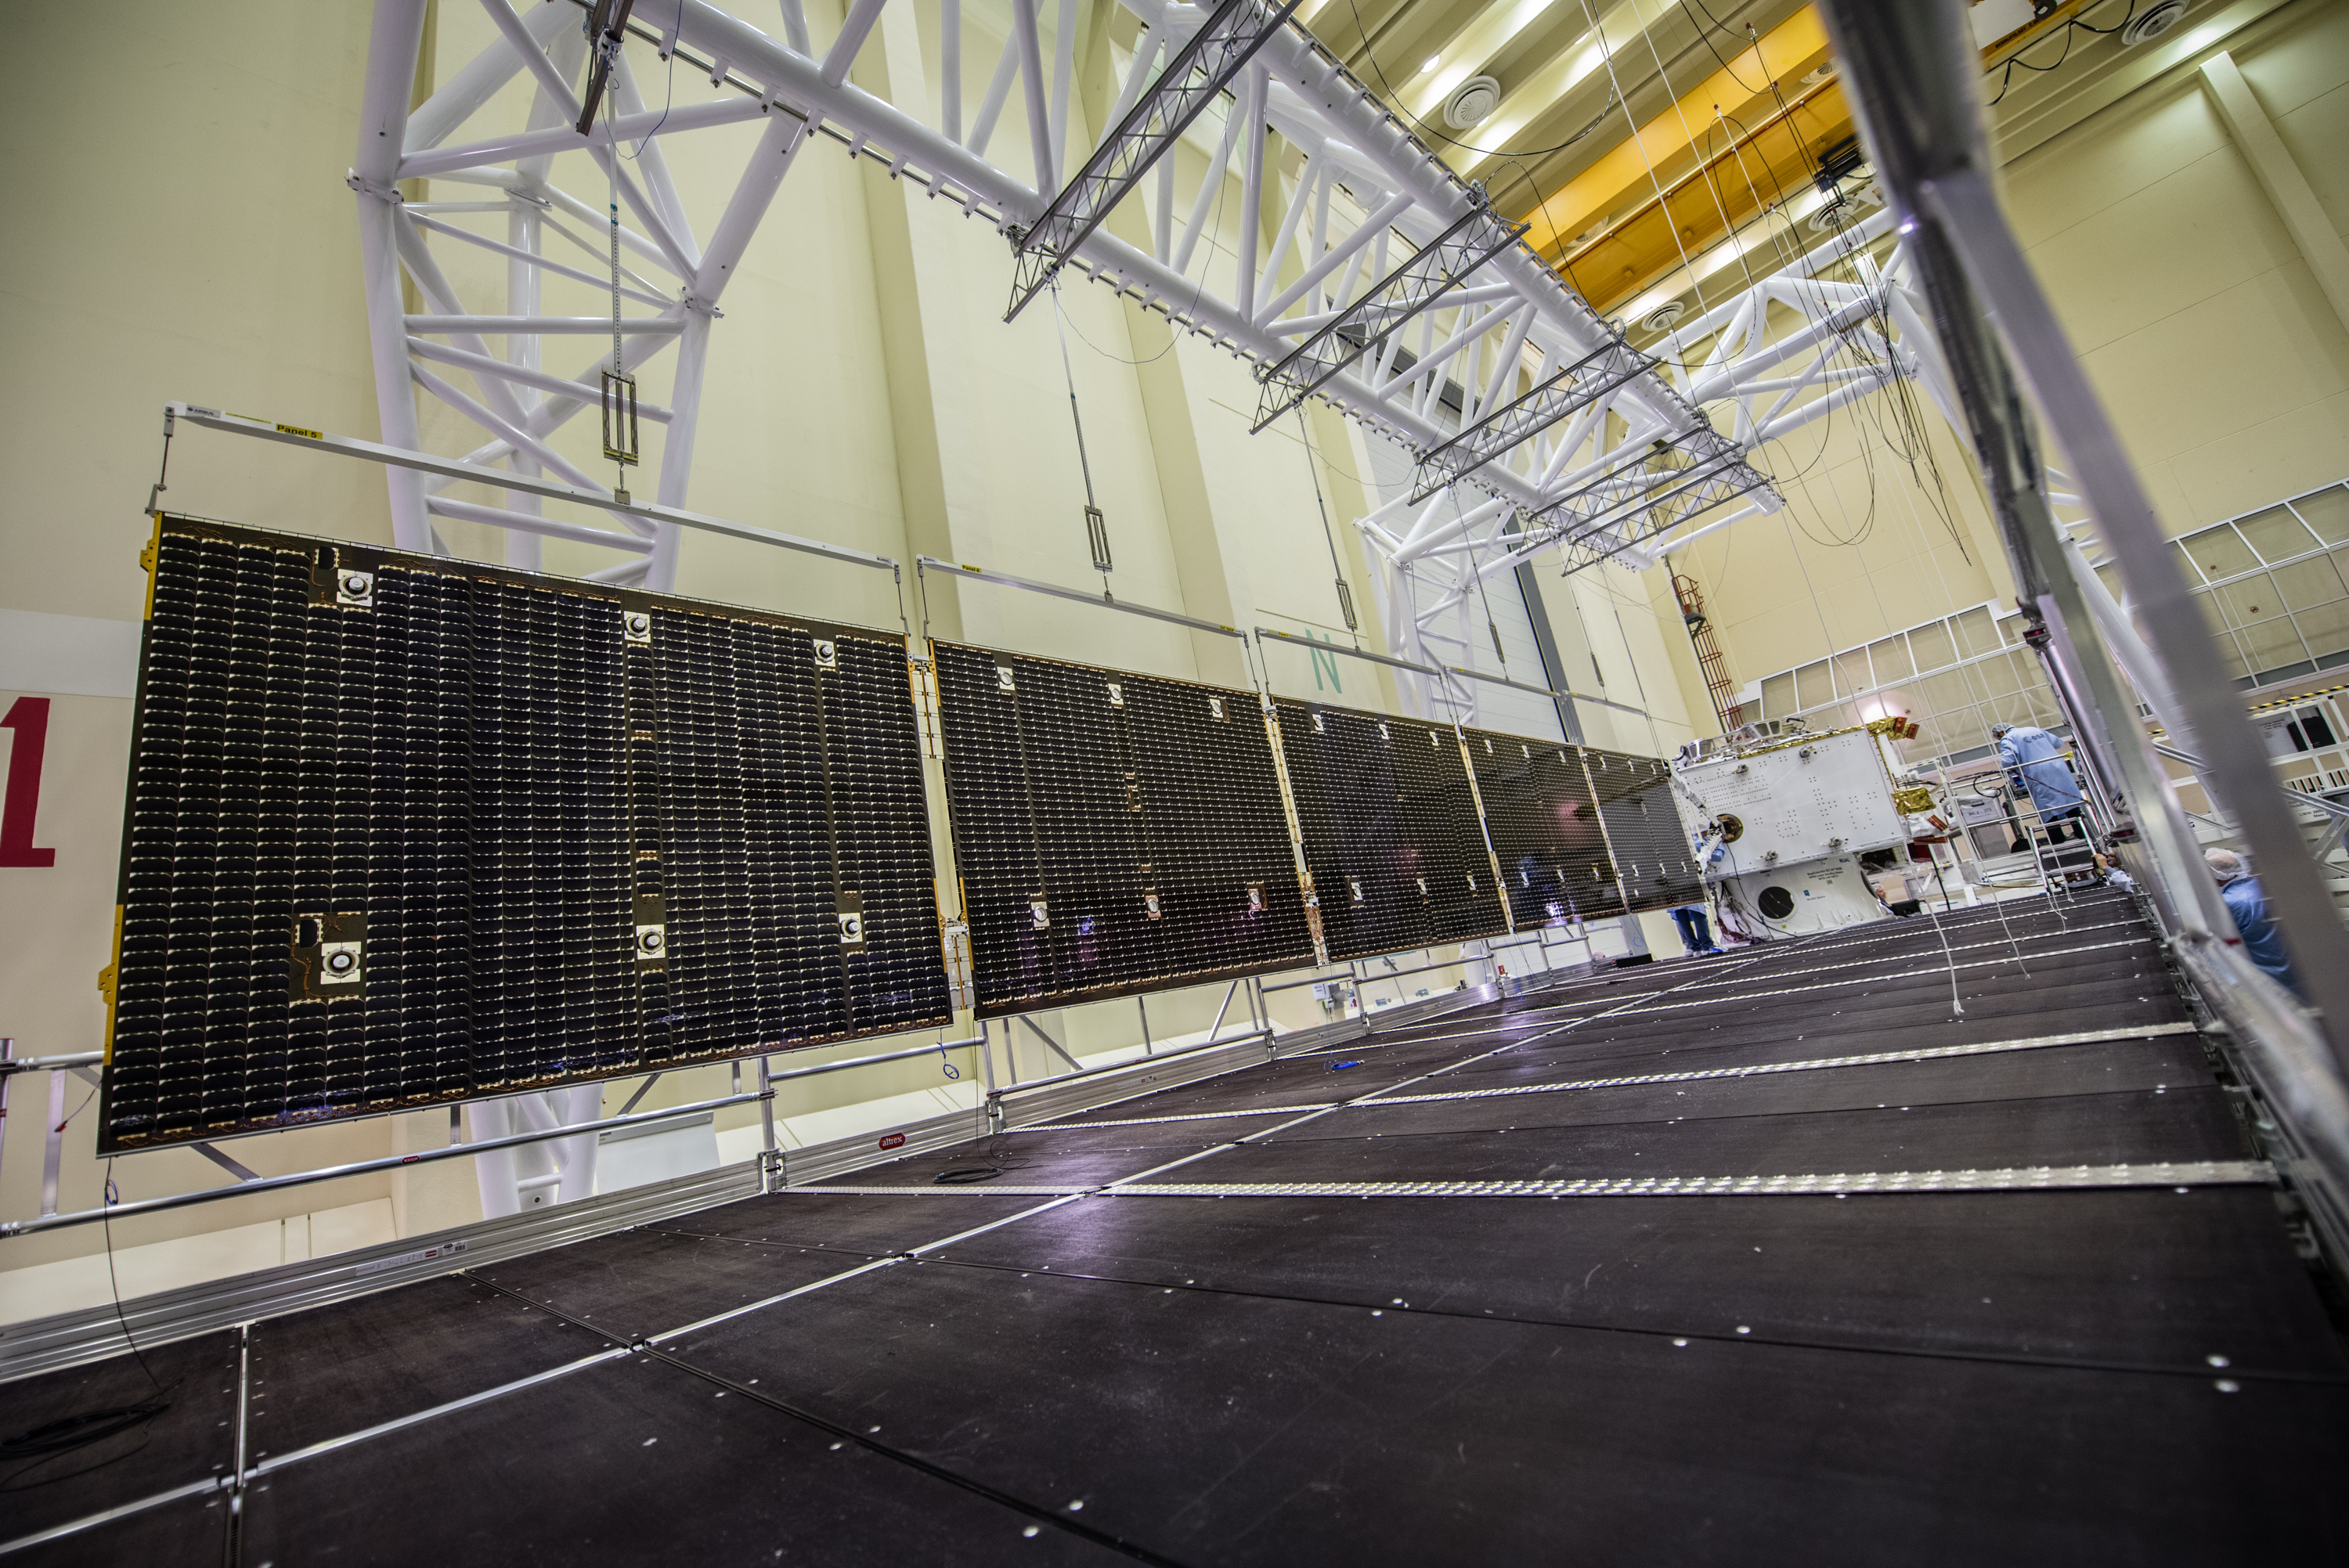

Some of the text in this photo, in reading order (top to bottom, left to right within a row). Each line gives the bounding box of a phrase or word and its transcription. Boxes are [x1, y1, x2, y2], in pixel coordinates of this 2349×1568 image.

[277, 424, 308, 436] Panel
[1305, 629, 1342, 694] N
[0, 697, 56, 867] 1
[882, 1137, 903, 1147] altrex
